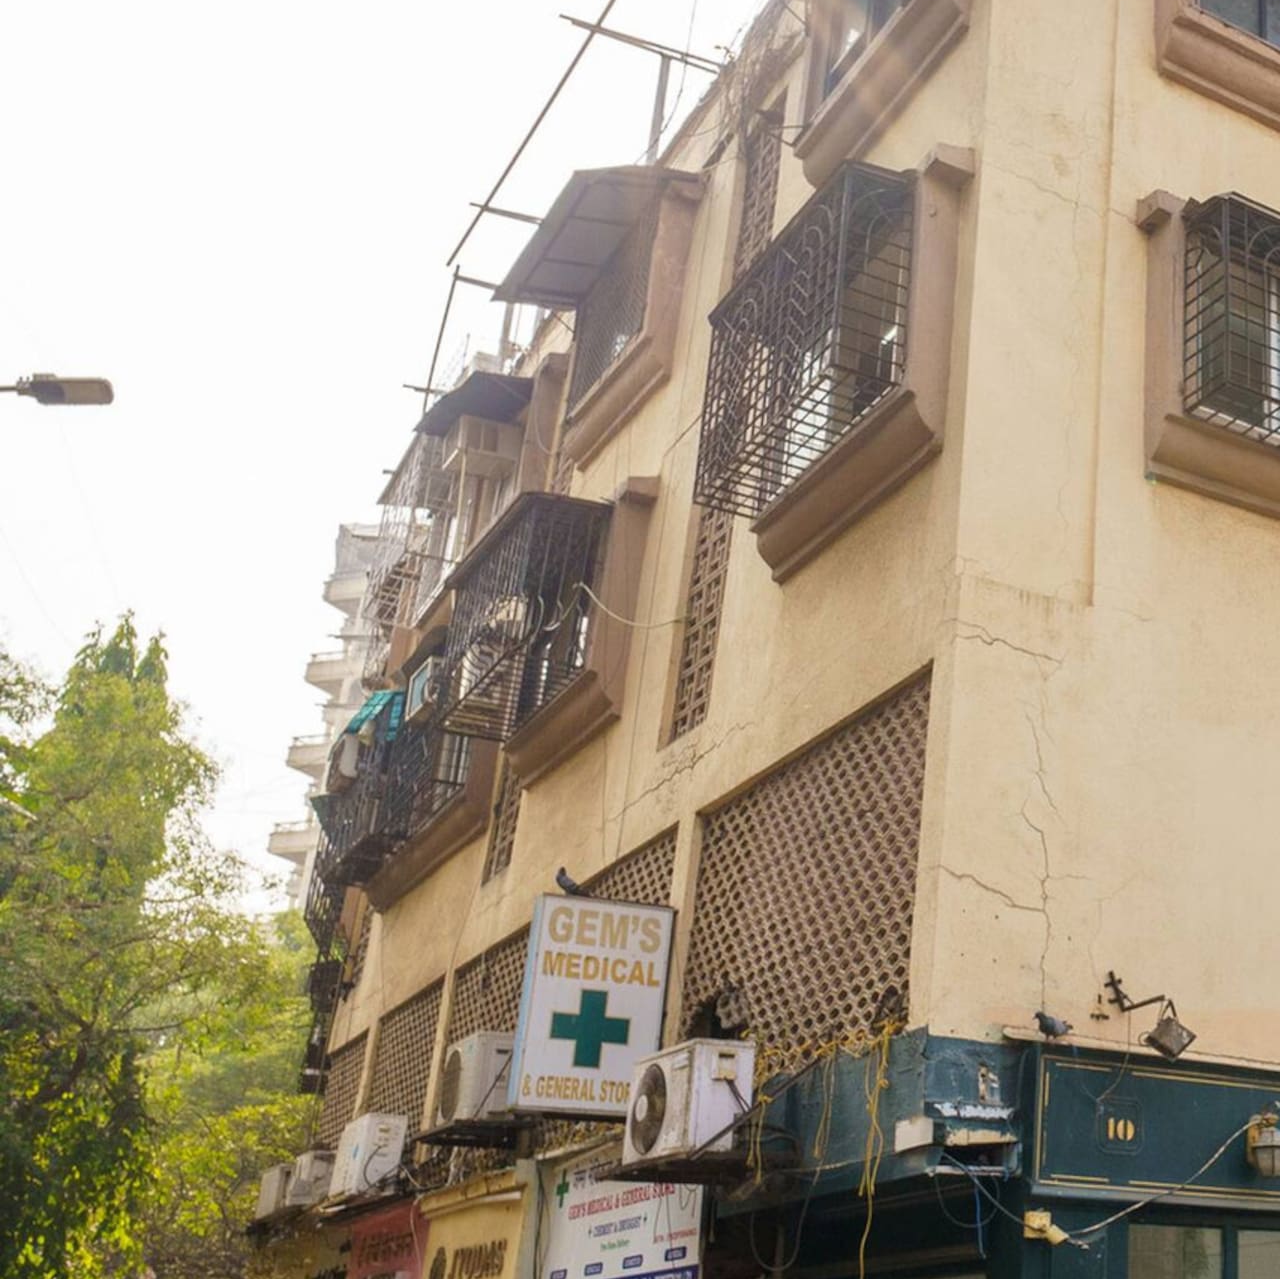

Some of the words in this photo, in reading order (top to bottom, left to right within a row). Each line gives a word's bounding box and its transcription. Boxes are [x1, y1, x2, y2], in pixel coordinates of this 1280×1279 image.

[548, 906, 662, 954] GEM'S
[542, 950, 660, 988] MEDICAL
[521, 1073, 531, 1097] &
[535, 1076, 596, 1102] GENERAL
[1107, 1117, 1136, 1142] 10
